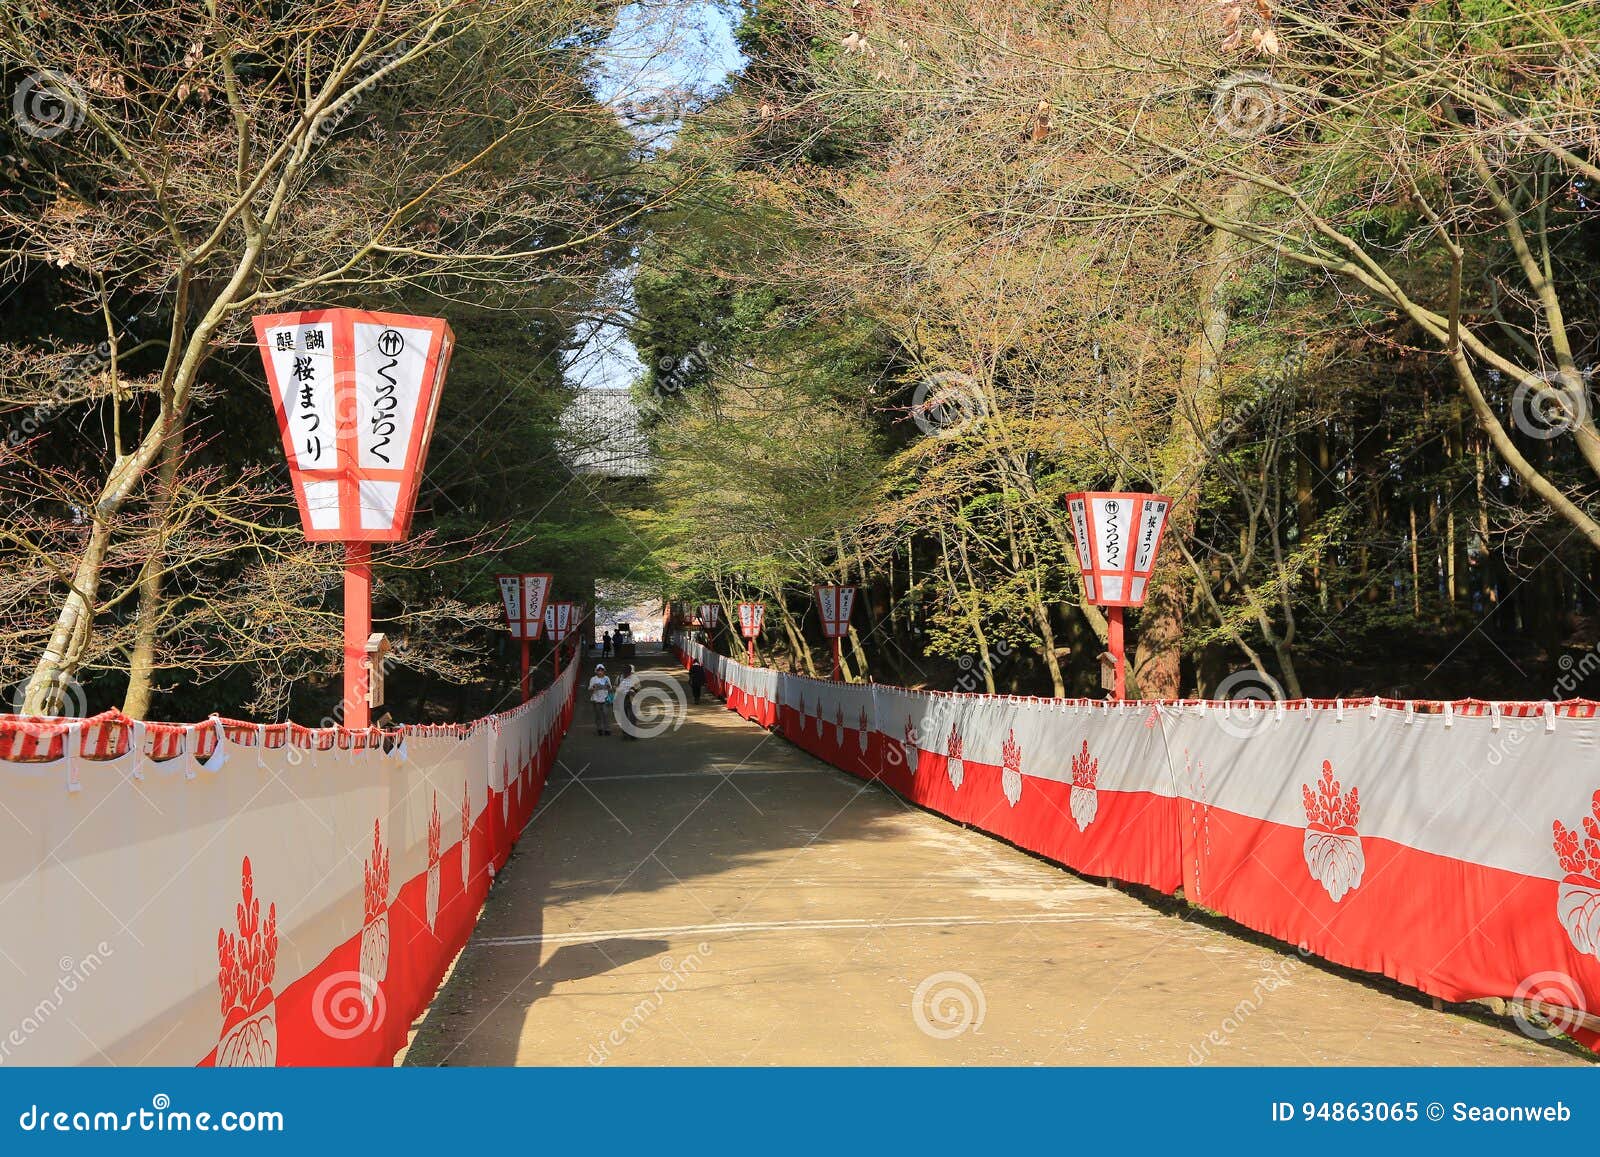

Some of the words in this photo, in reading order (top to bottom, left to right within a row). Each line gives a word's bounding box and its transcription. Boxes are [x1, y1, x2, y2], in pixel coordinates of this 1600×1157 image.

[293, 356, 321, 462] 桜まつり
[369, 358, 398, 464] くろちく
[1106, 515, 1120, 568] くろちく
[1140, 515, 1158, 567] 桜まつり
